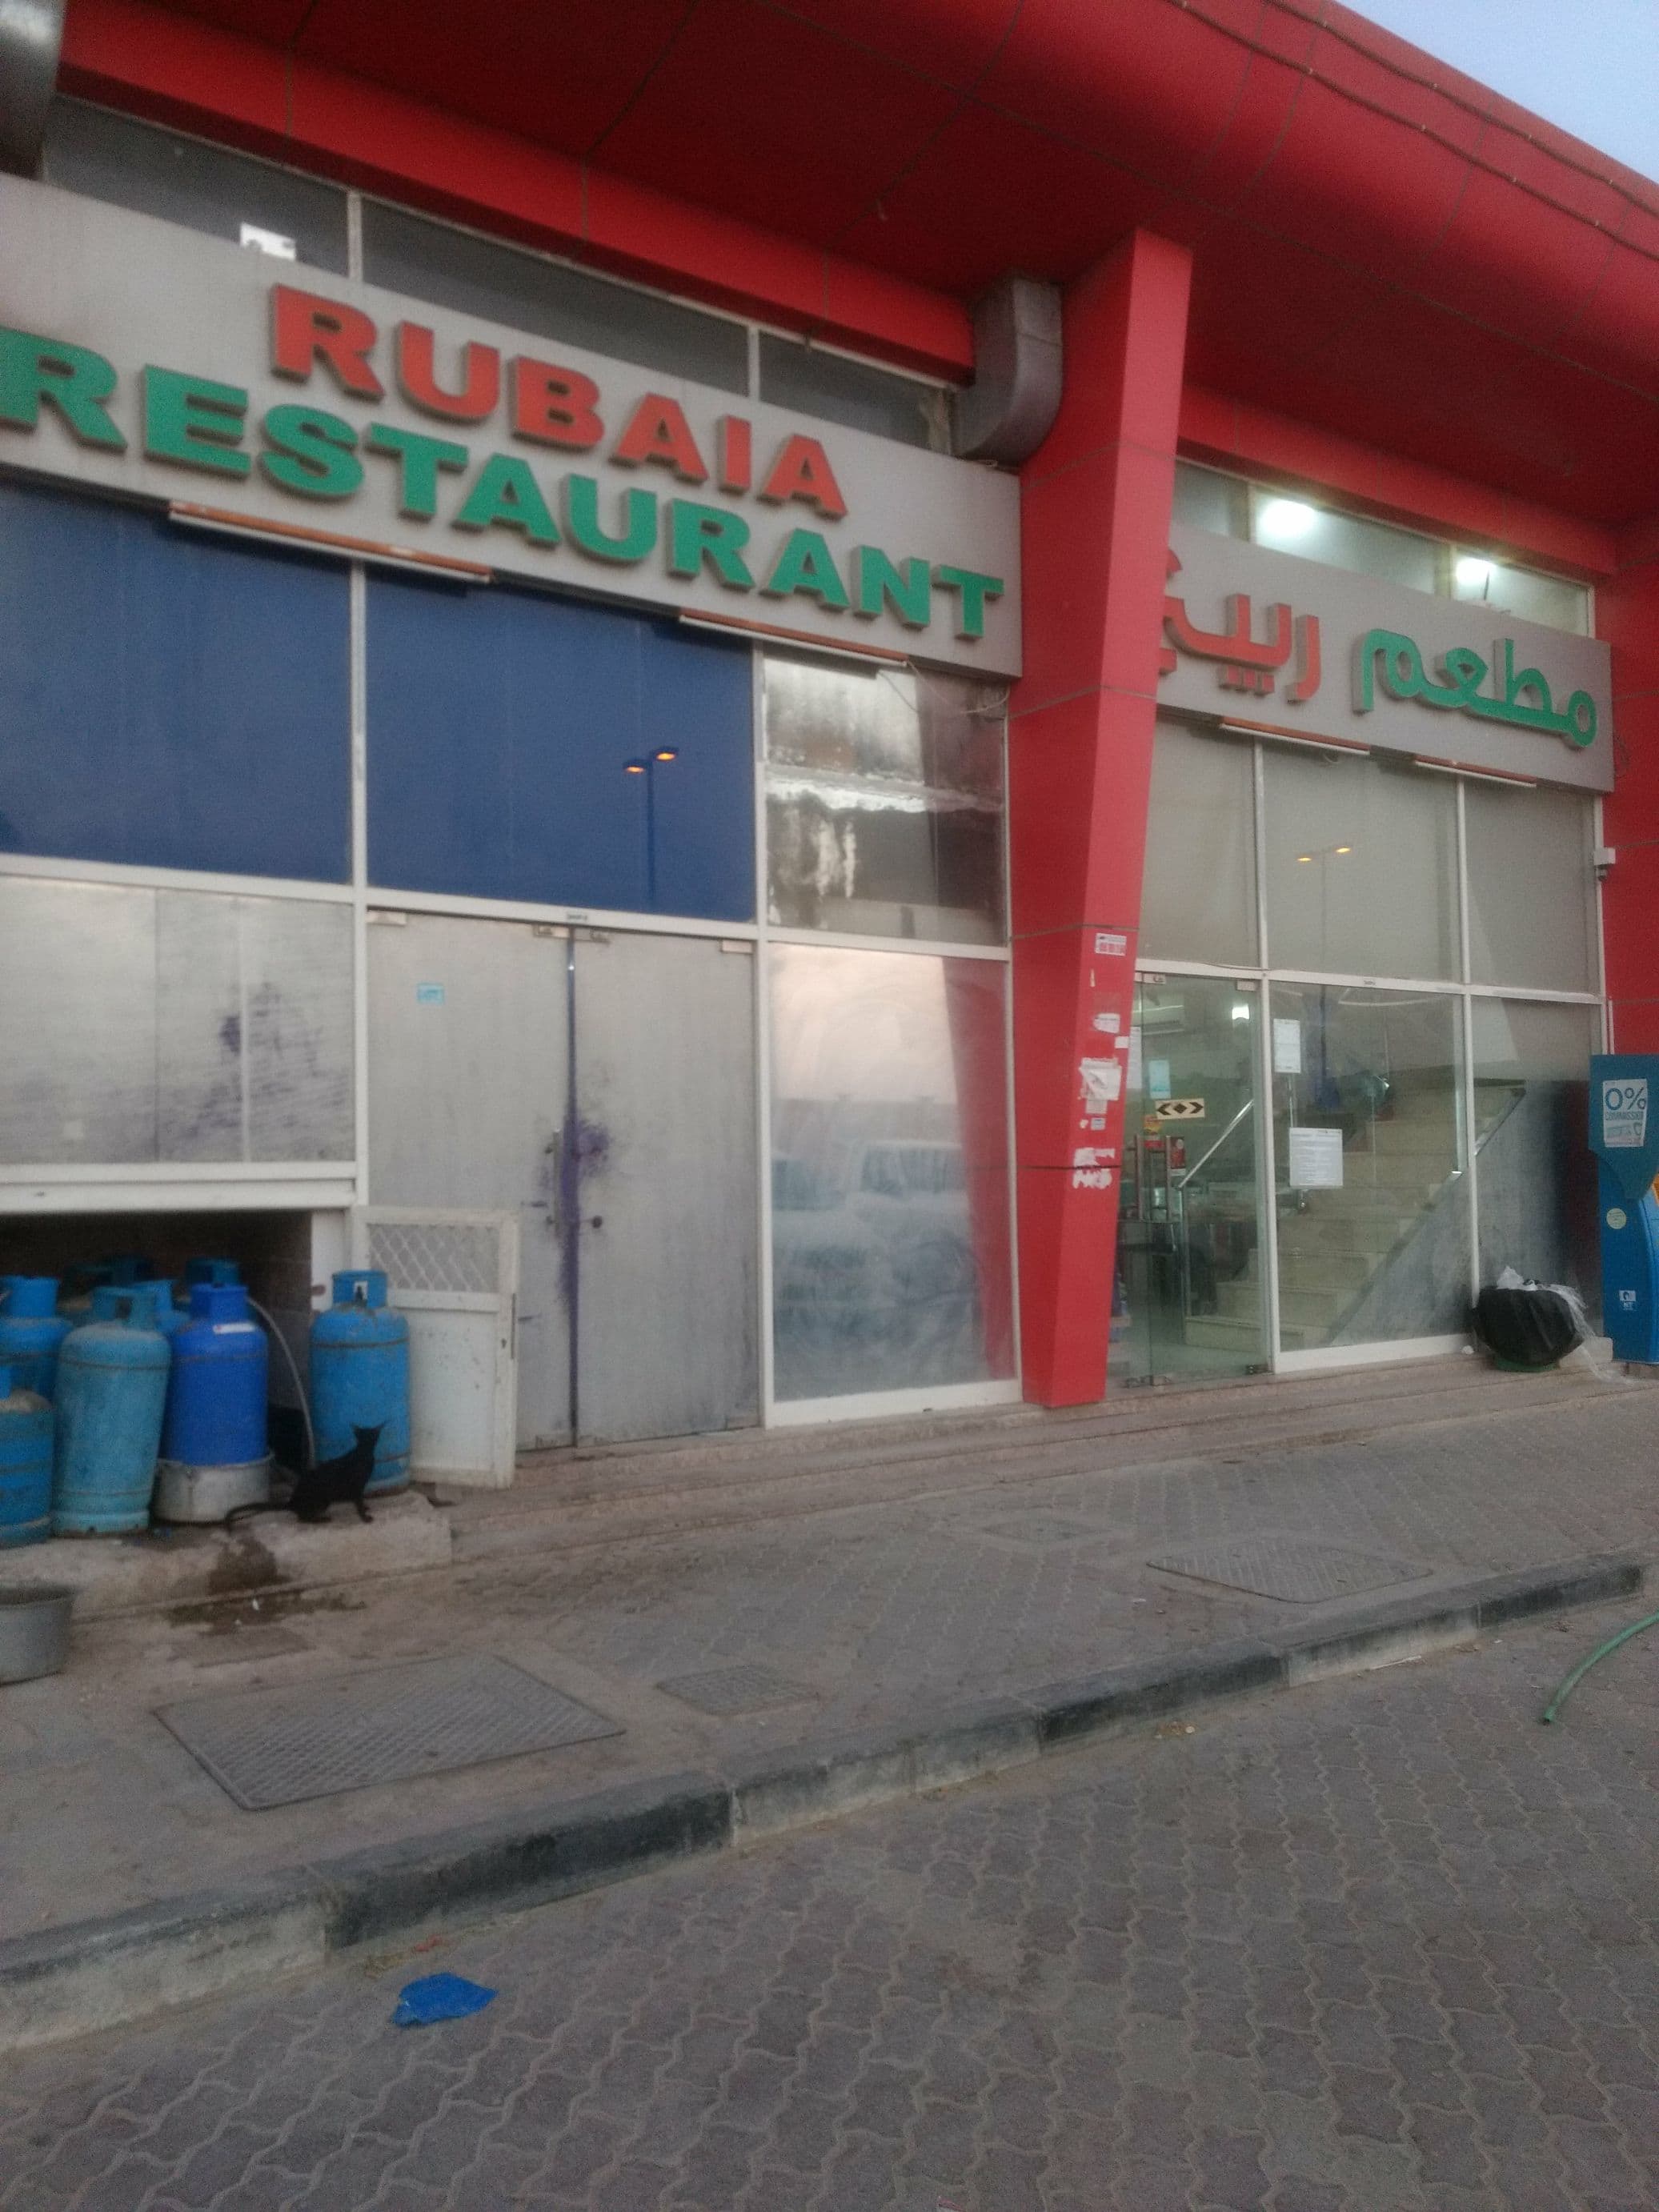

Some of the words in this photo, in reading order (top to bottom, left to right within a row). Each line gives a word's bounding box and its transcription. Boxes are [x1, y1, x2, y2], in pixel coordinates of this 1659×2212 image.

[0, 327, 1004, 640] RESTAURANT
[270, 283, 848, 520] RUBAIA
[1354, 627, 1597, 749] مطعم
[1605, 1087, 1646, 1111] 0%
